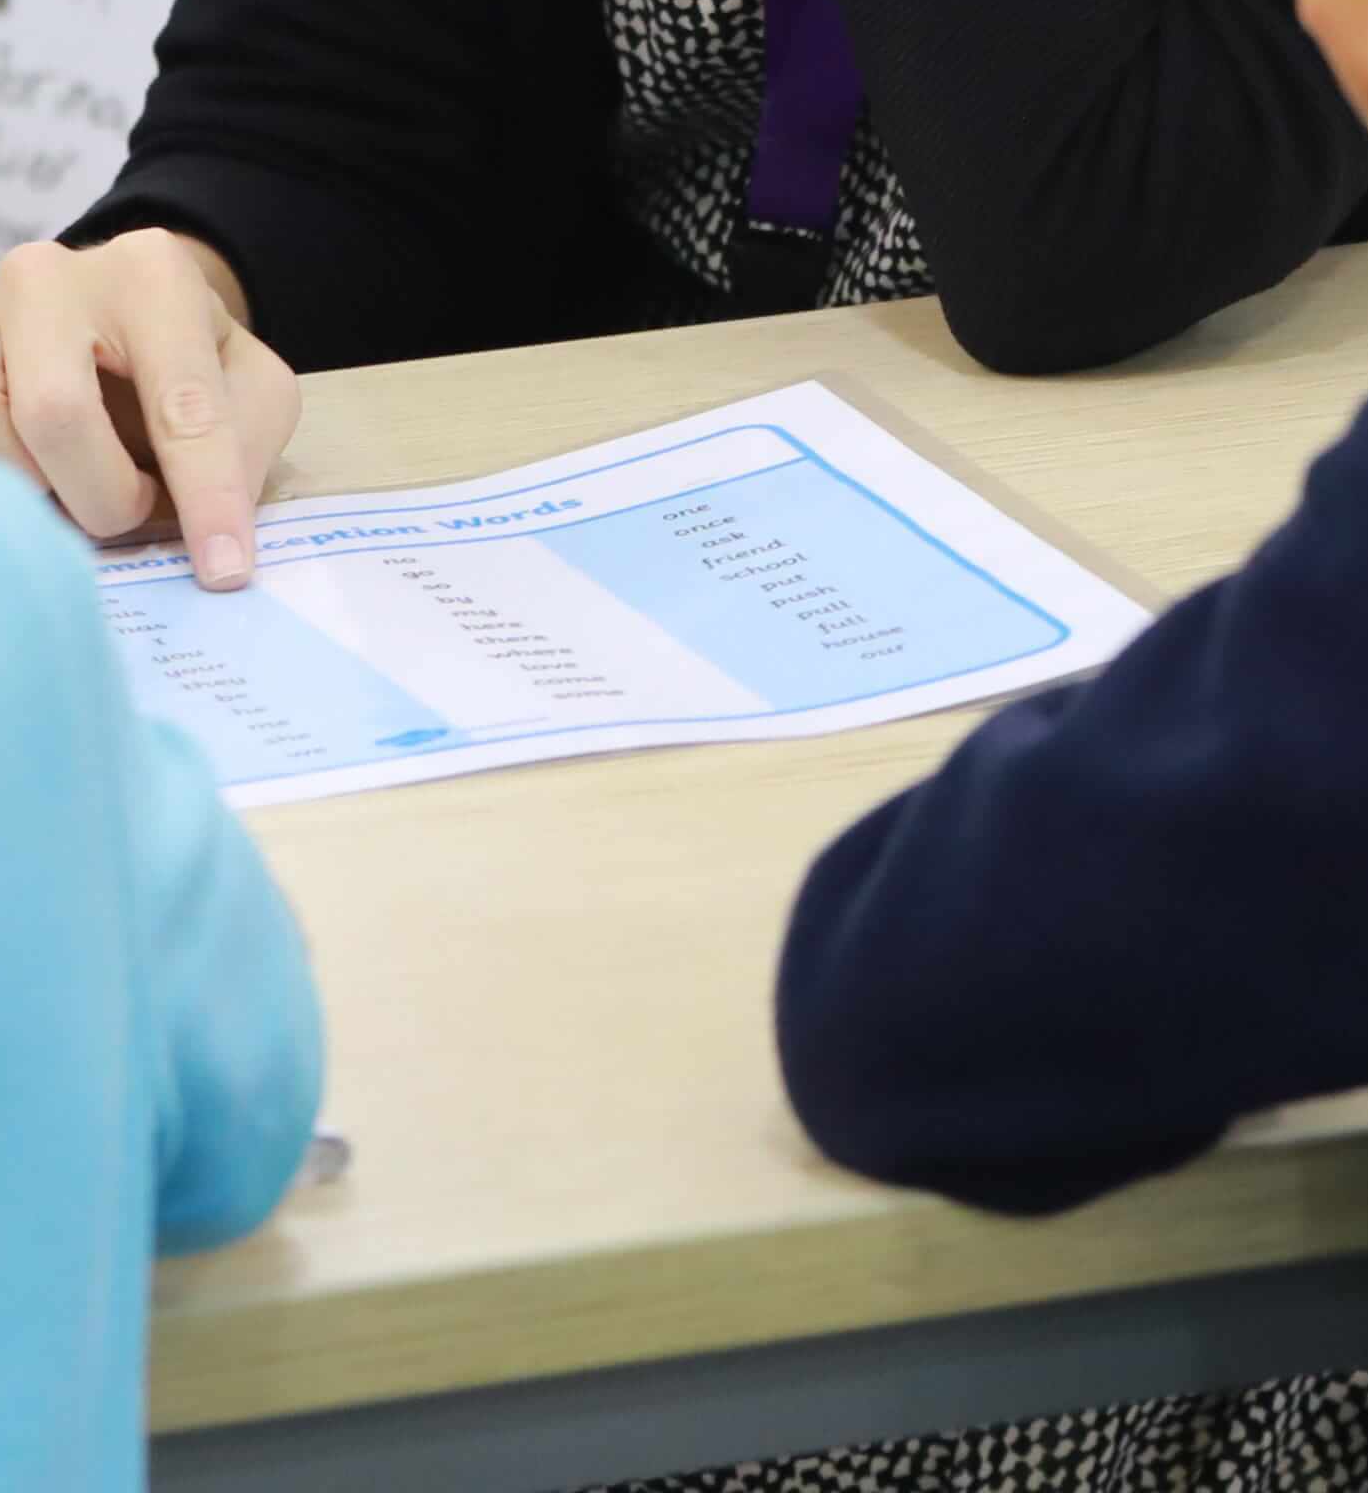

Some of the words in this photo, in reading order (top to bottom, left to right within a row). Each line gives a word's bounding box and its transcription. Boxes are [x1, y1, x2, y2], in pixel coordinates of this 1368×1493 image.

[663, 503, 711, 521] one
[261, 524, 428, 550] ception
[435, 498, 584, 530] Words
[674, 516, 736, 537] once
[701, 531, 748, 548] ask
[701, 538, 788, 570] friend
[719, 552, 808, 581] school
[760, 573, 807, 593] put
[771, 585, 839, 609] push
[797, 599, 853, 621] pull
[818, 613, 869, 634] full
[820, 625, 903, 650] house
